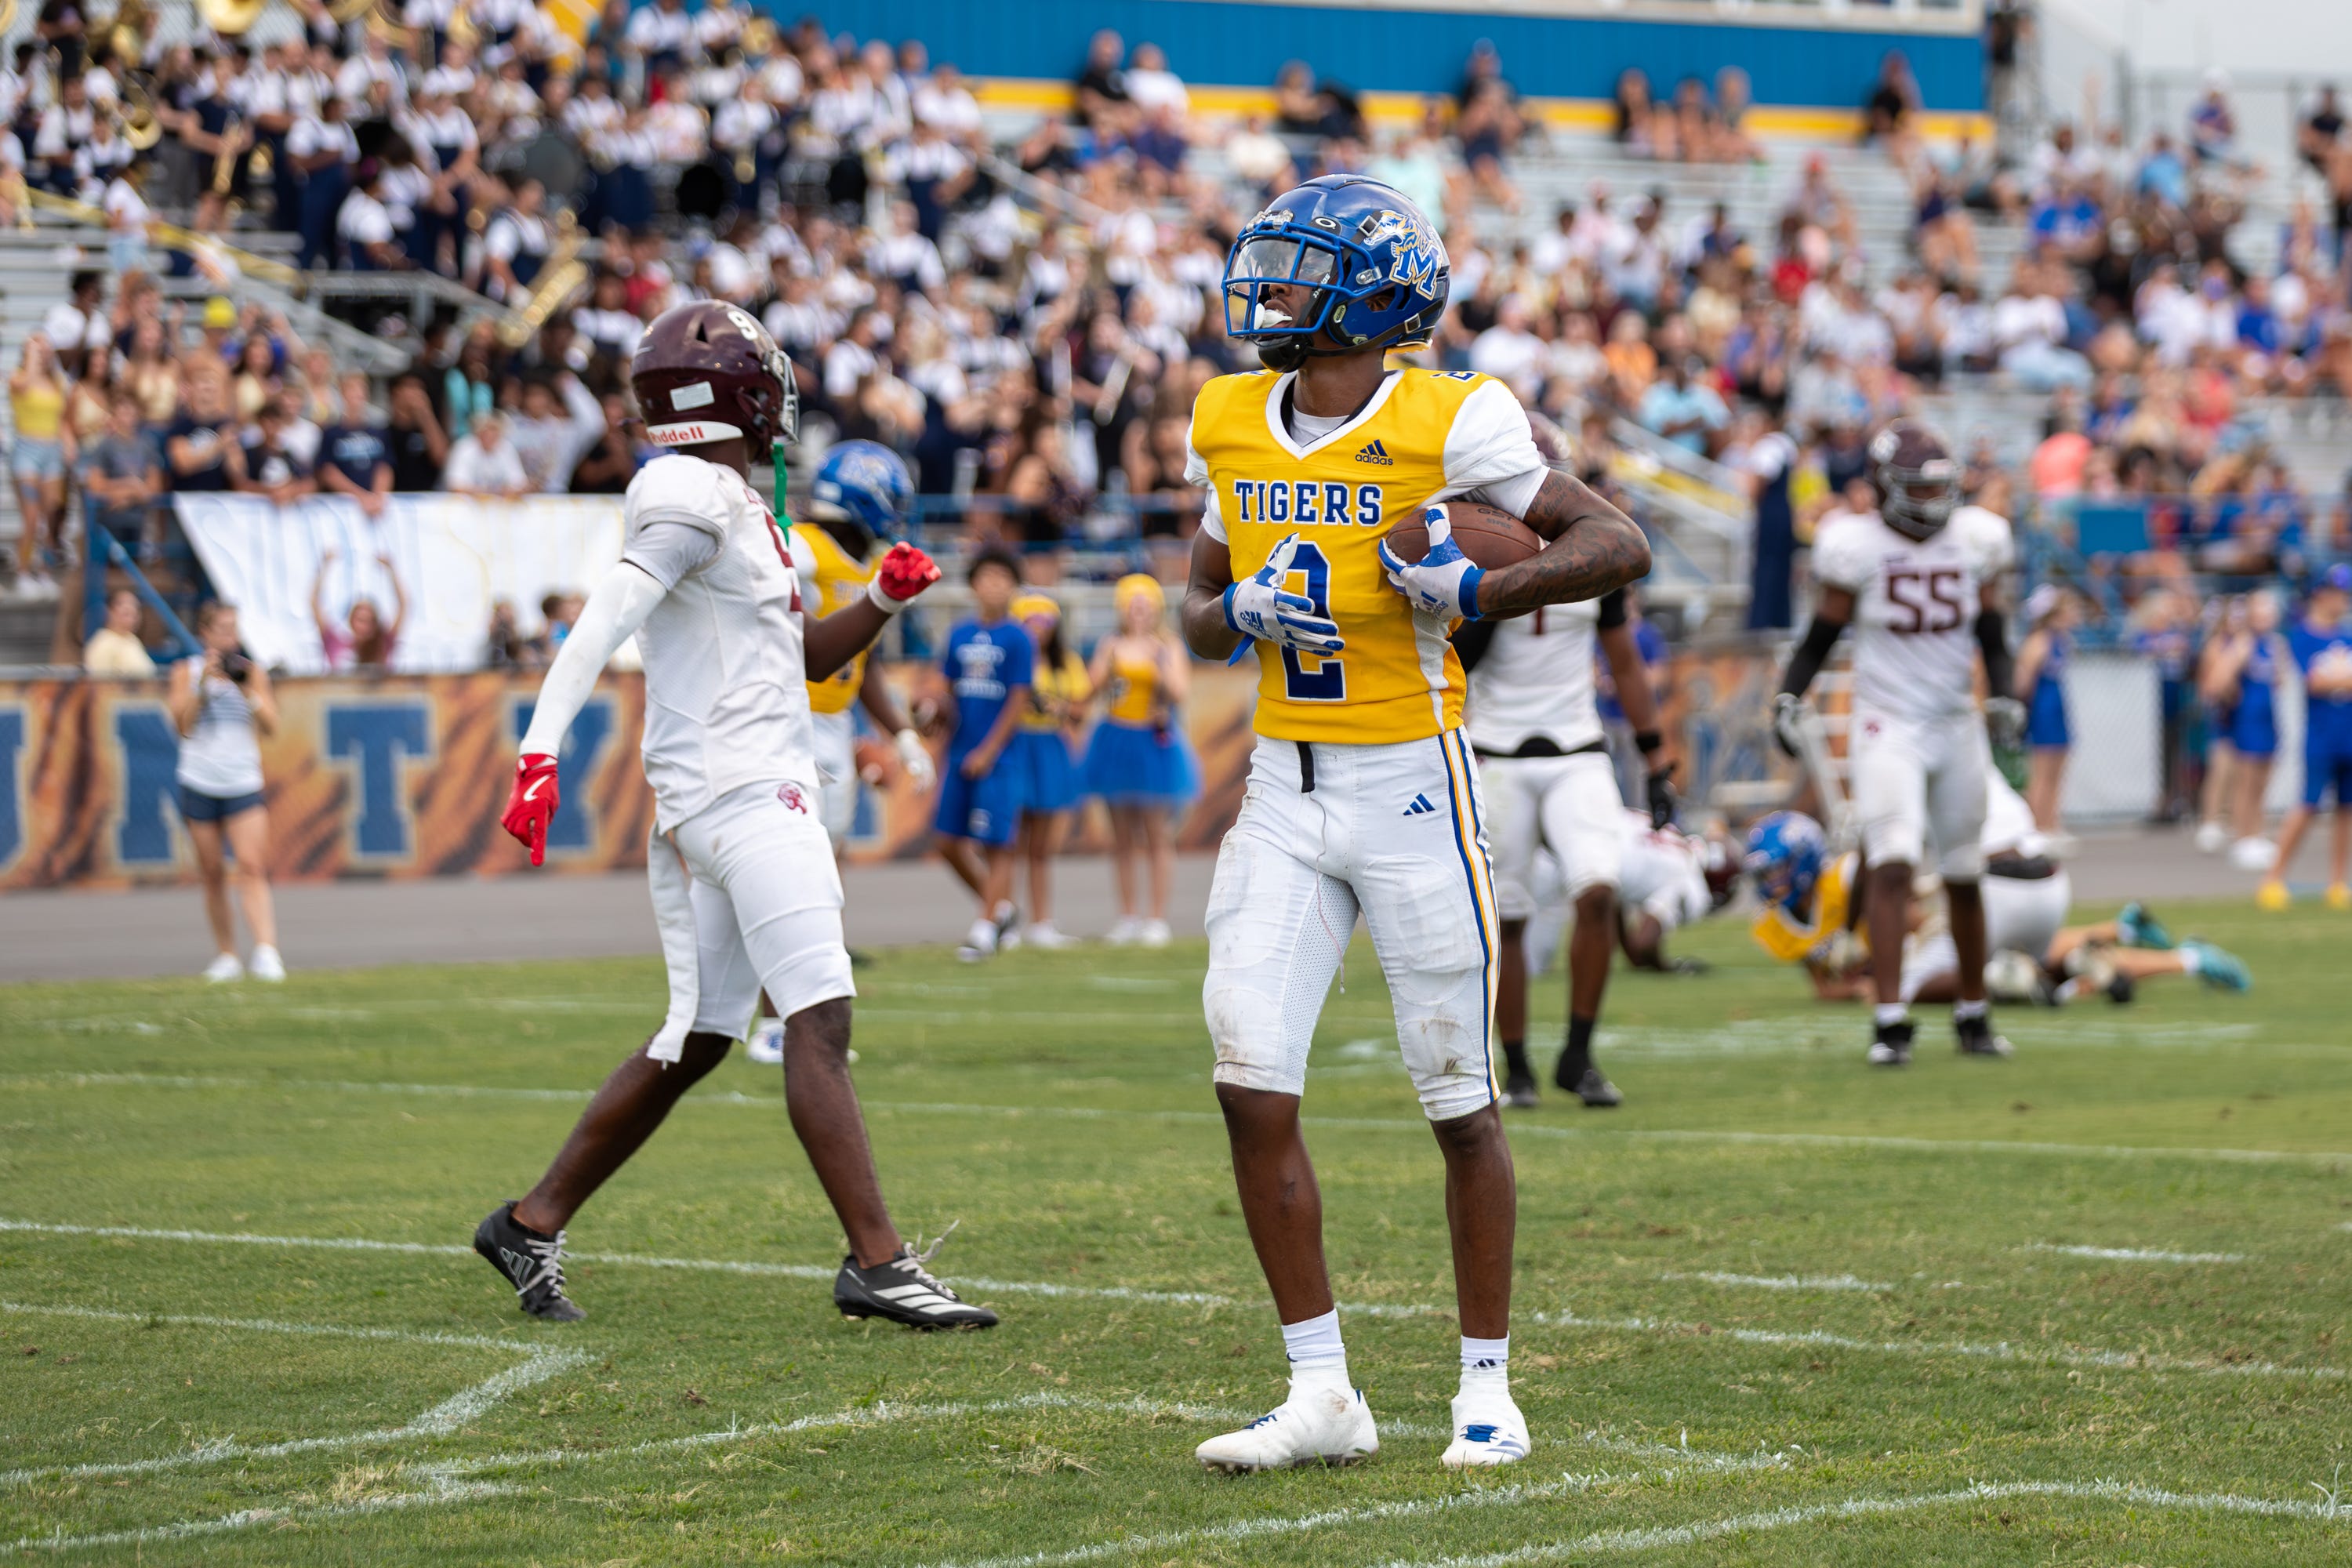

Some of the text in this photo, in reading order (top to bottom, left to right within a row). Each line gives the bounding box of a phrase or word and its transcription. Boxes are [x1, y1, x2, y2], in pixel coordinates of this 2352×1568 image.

[728, 310, 758, 340] 9
[1355, 452, 1394, 466] adidas
[1234, 479, 1384, 528] TIGERS
[1266, 541, 1347, 701] 2
[1887, 568, 1962, 633] 55
